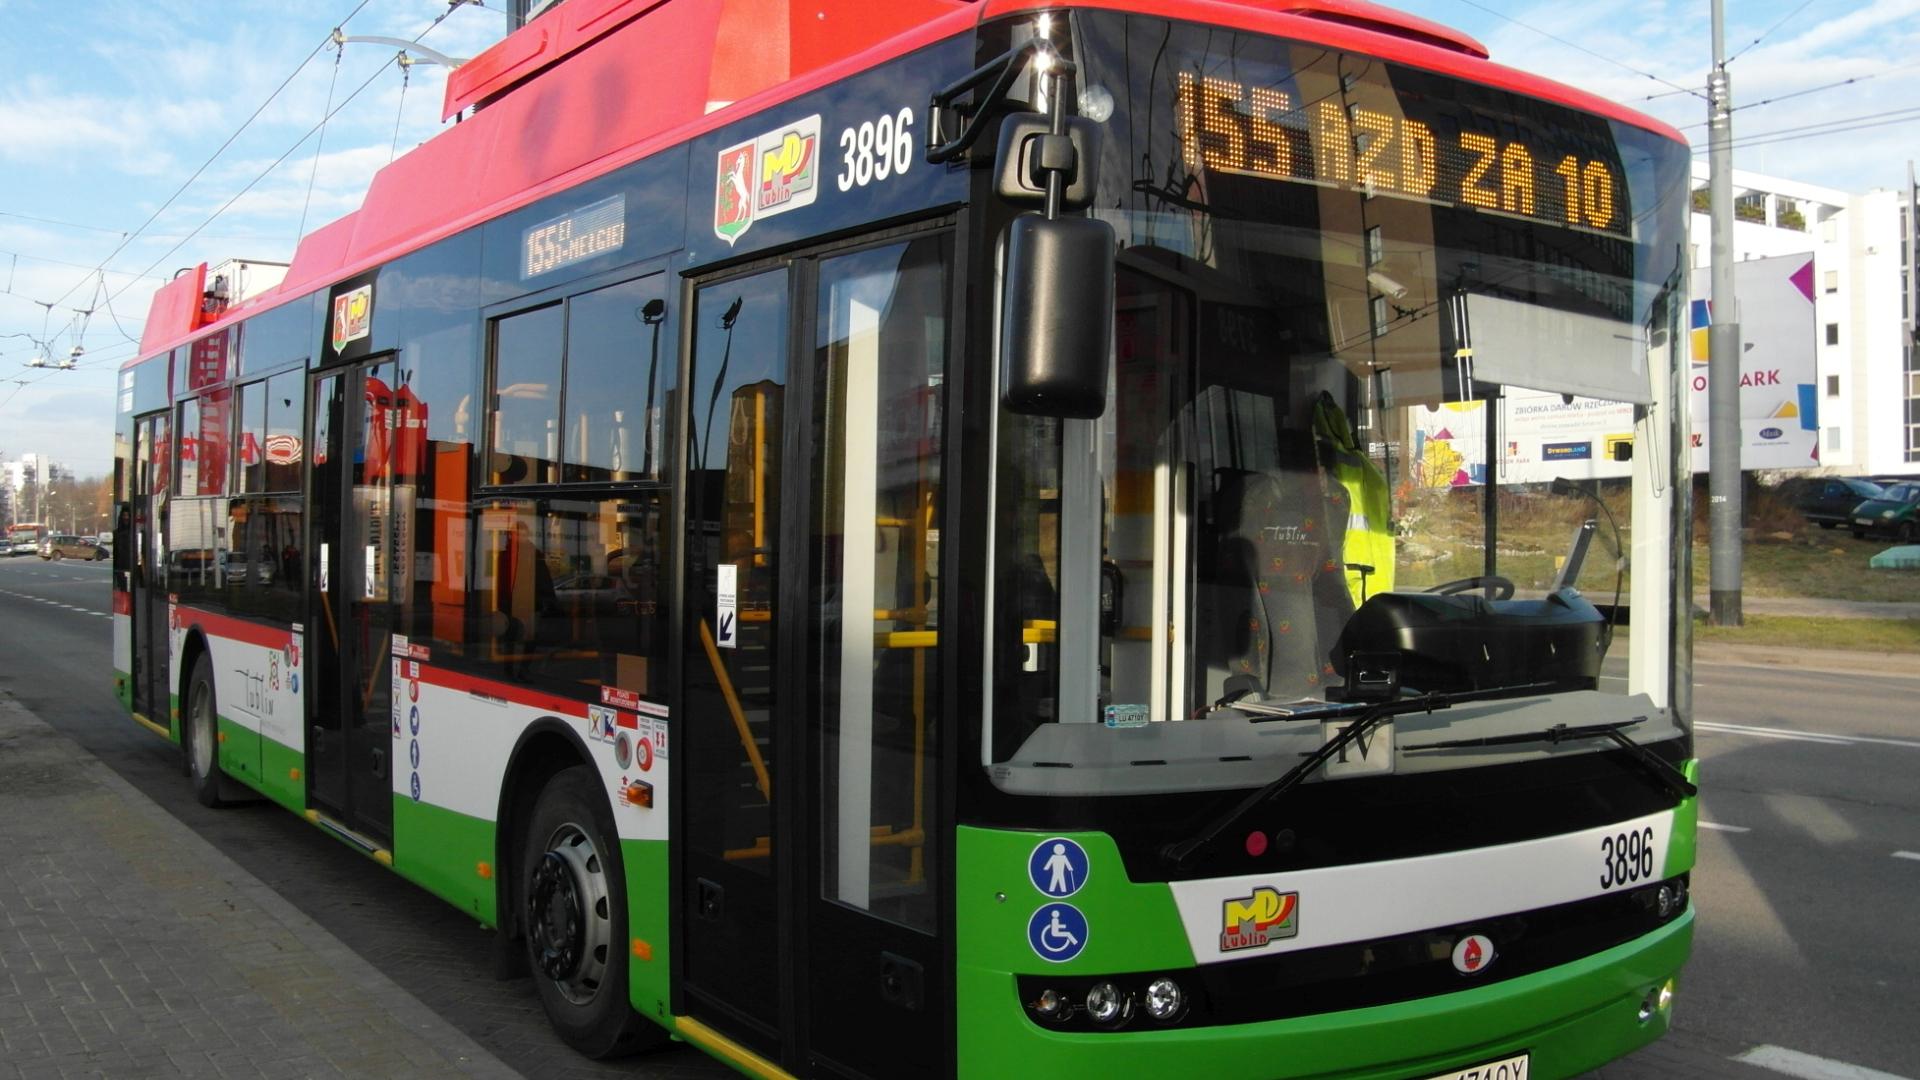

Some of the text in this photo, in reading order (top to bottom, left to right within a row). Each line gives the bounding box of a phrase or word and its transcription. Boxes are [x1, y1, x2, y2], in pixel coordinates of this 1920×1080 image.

[837, 106, 914, 193] 3896
[1319, 102, 1437, 196] AZD
[1459, 131, 1535, 217] ZA
[1555, 153, 1614, 229] 10
[759, 187, 791, 208] Lublin
[1739, 368, 1781, 388] ARK
[1600, 826, 1654, 890] 3896
[1222, 931, 1267, 949] Lublin
